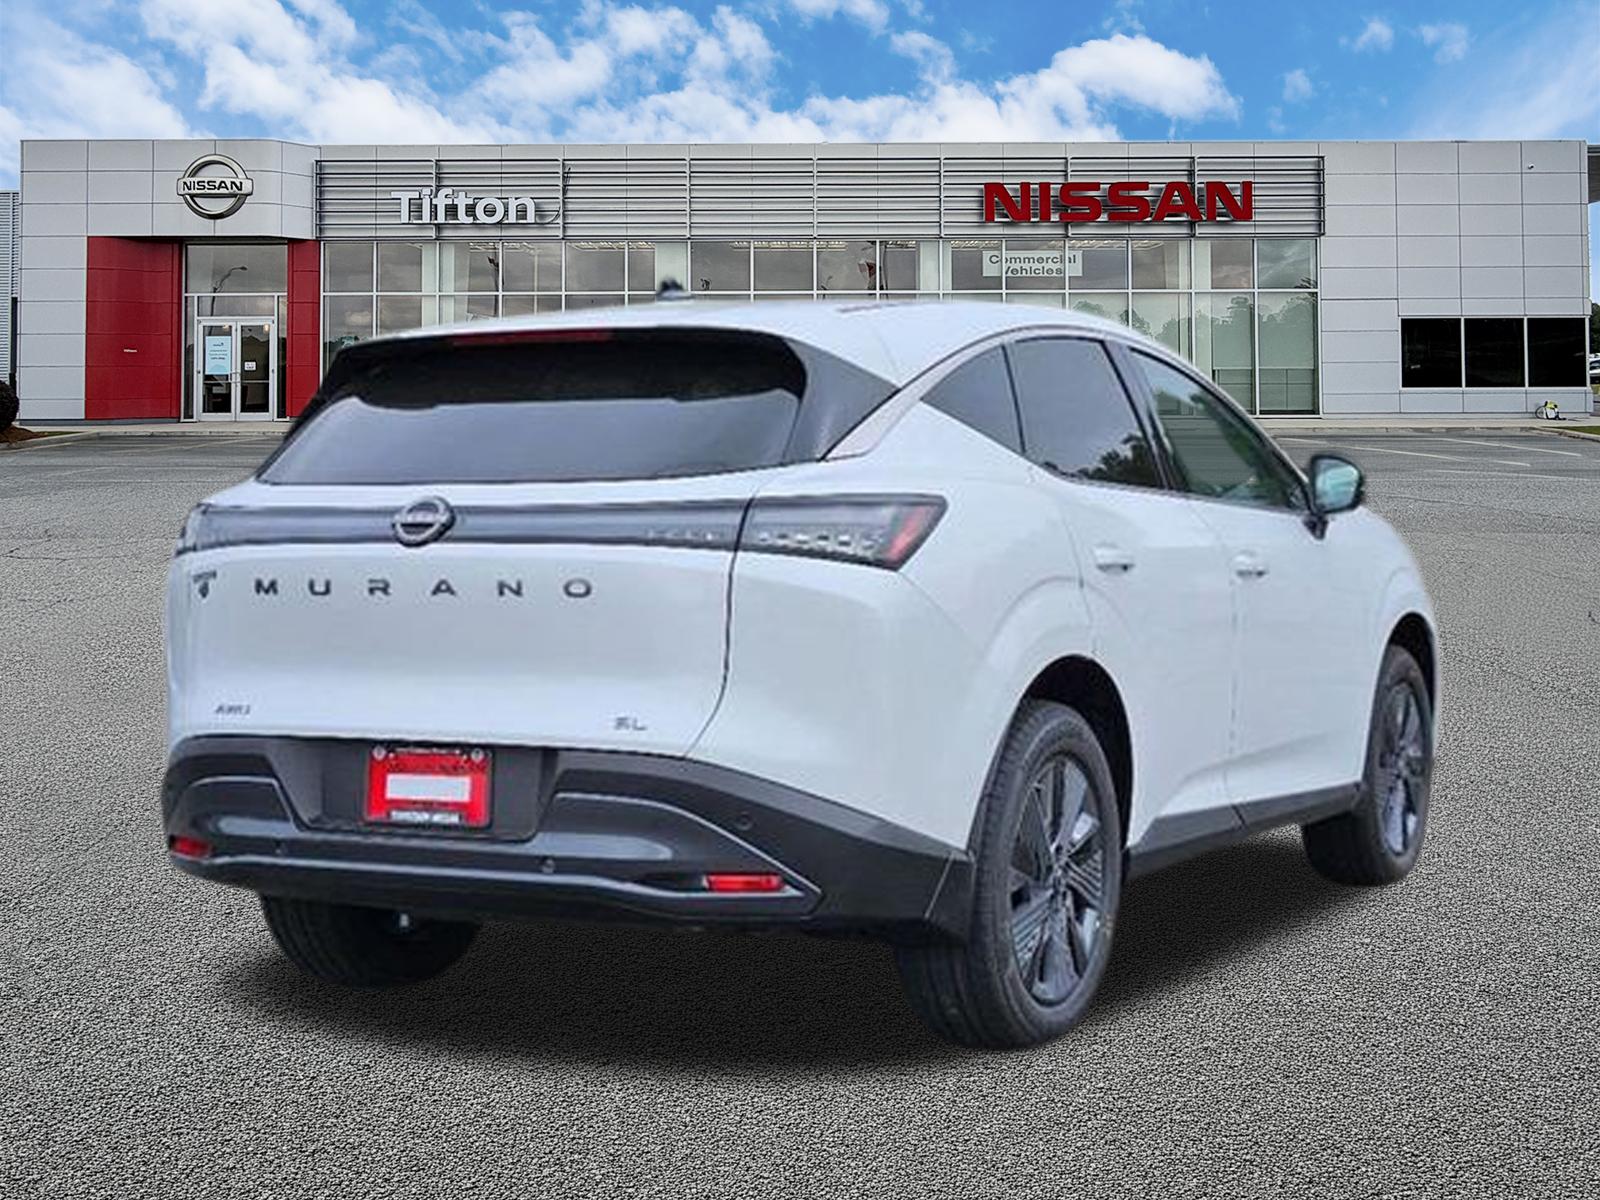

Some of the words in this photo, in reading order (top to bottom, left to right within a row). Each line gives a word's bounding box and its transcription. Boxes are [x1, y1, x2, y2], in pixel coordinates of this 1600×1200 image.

[182, 180, 243, 192] NISSAN
[390, 188, 536, 224] Tifton
[983, 181, 1253, 222] NISSAN
[254, 577, 593, 599] MURANO
